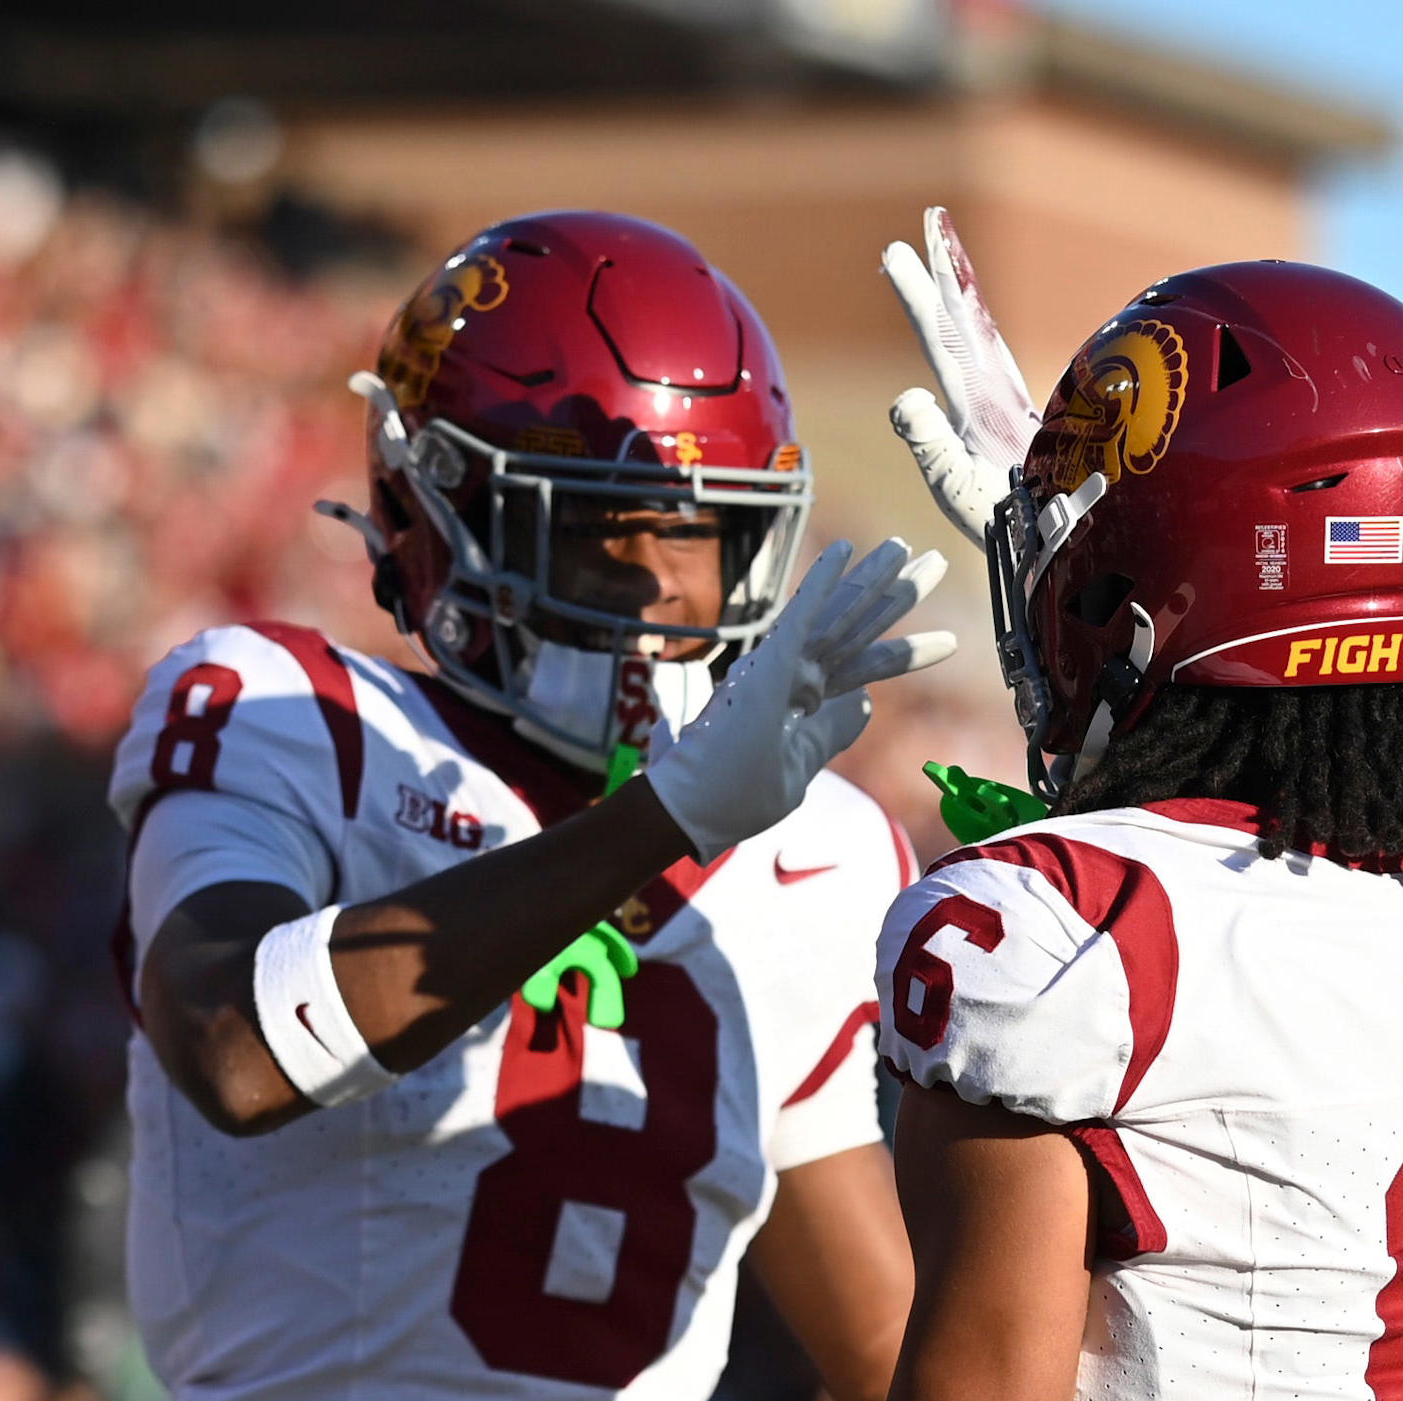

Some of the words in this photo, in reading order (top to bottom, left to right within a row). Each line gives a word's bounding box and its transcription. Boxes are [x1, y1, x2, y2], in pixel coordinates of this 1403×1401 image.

[151, 663, 243, 790] 8
[891, 894, 1005, 1051] 6
[449, 957, 719, 1390] 8
